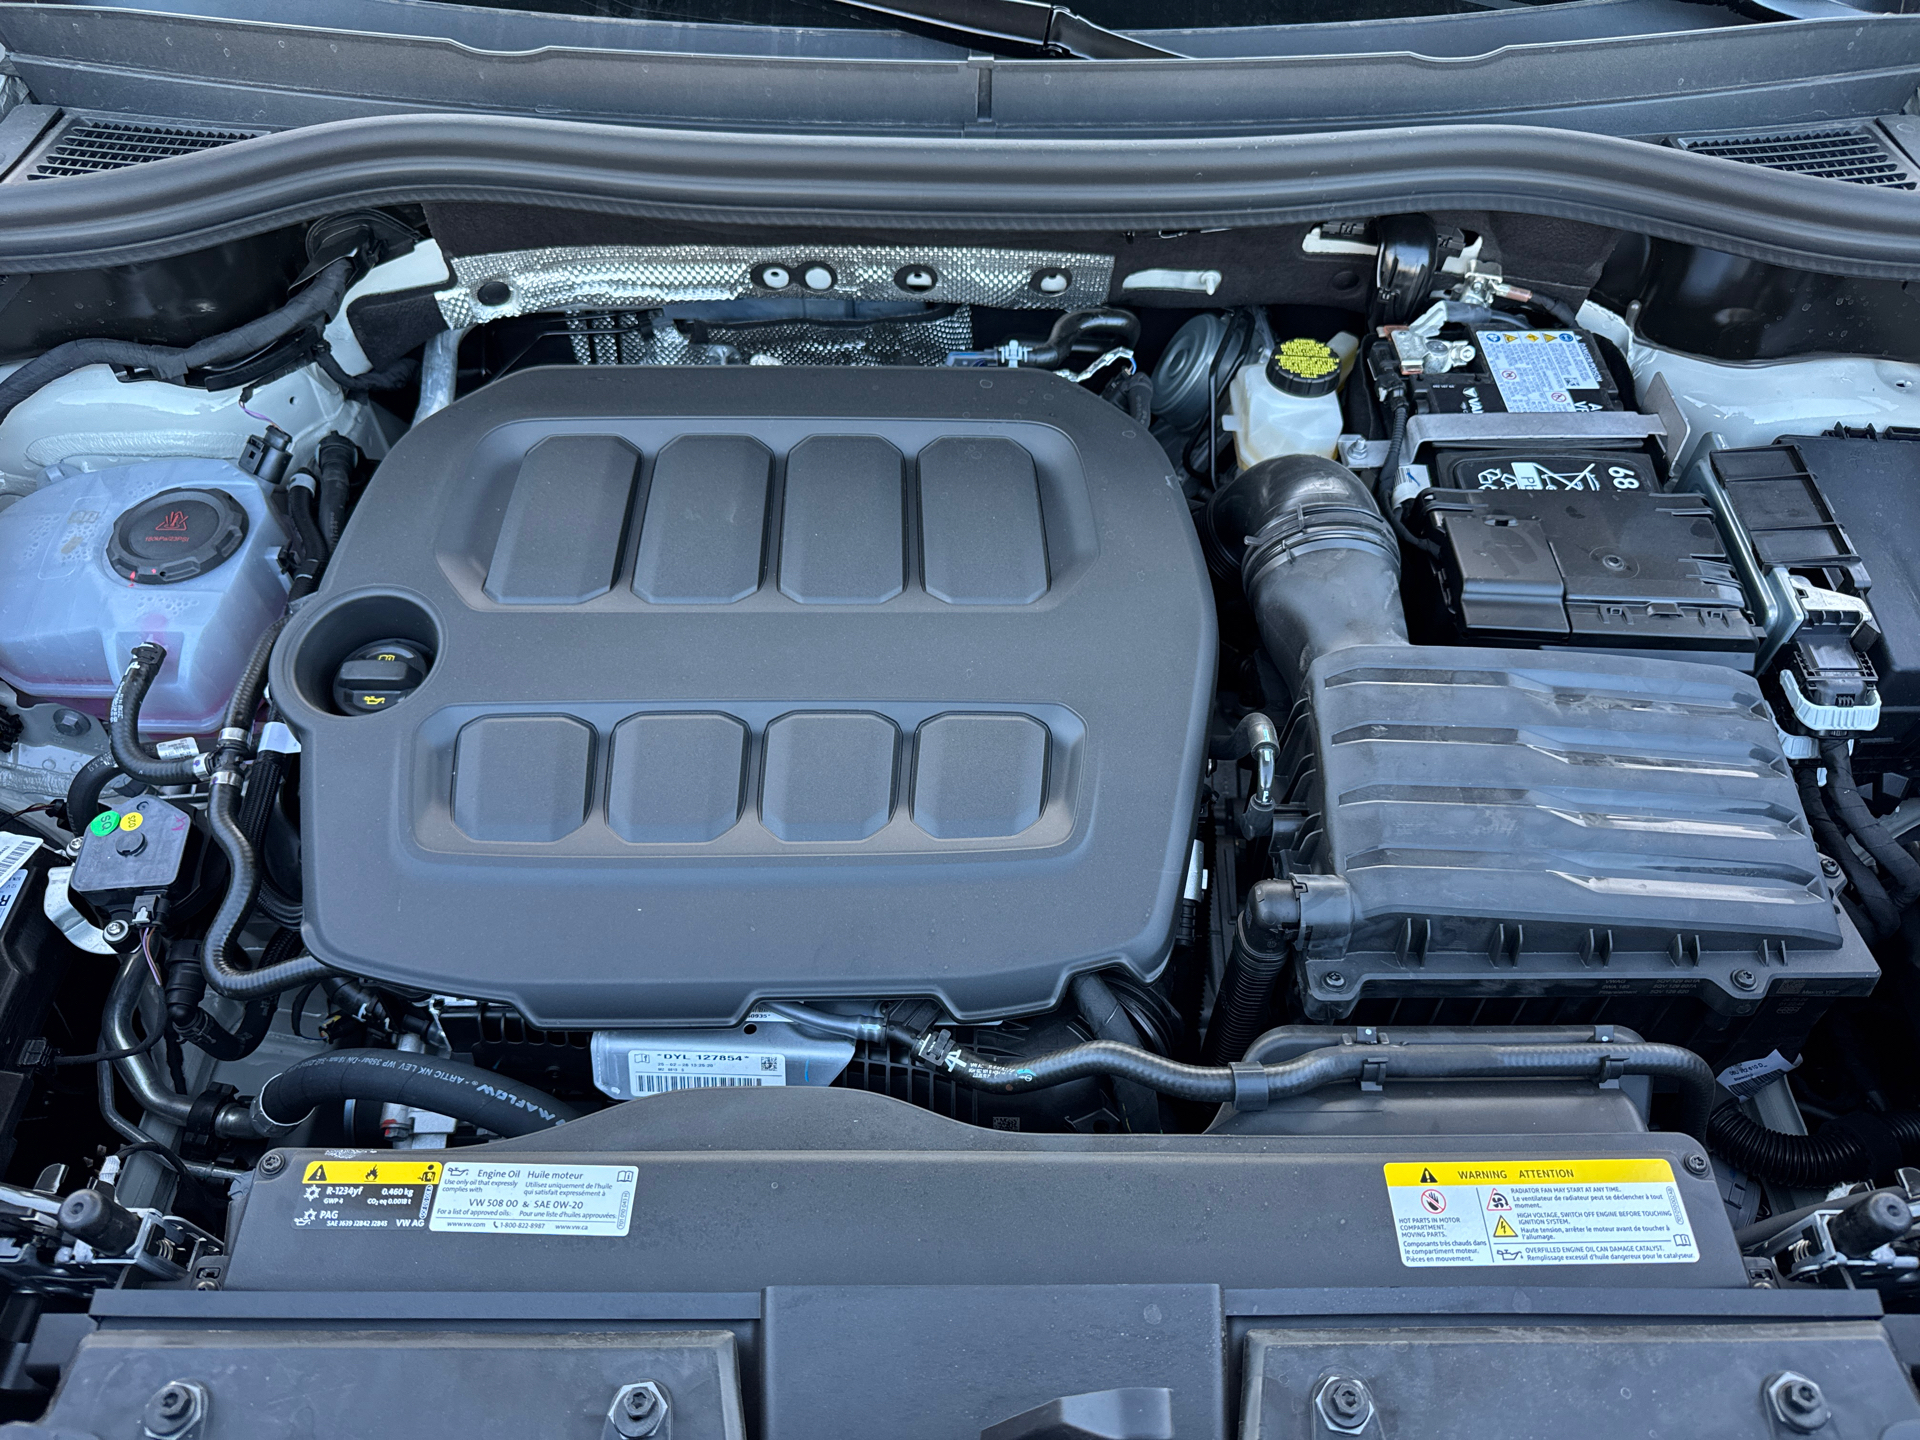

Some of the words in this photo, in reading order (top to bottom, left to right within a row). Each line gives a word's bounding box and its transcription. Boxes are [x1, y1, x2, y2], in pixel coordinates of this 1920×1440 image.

[382, 1060, 396, 1069] WP
[398, 1062, 418, 1073] LEV
[417, 1066, 433, 1078] NK
[434, 1072, 466, 1084] ARTIC
[477, 1170, 506, 1179] Engine
[508, 1170, 521, 1178] Oil
[528, 1171, 551, 1179] Huile
[1457, 1170, 1507, 1180] WARNING
[1519, 1169, 1574, 1179] ATTENTION
[326, 1186, 364, 1197] R-1234yf
[382, 1188, 403, 1196] 0.460
[404, 1188, 414, 1197] kg
[487, 1199, 504, 1207] 508
[553, 1201, 583, 1209] 0W-20
[320, 1211, 338, 1219] PAG
